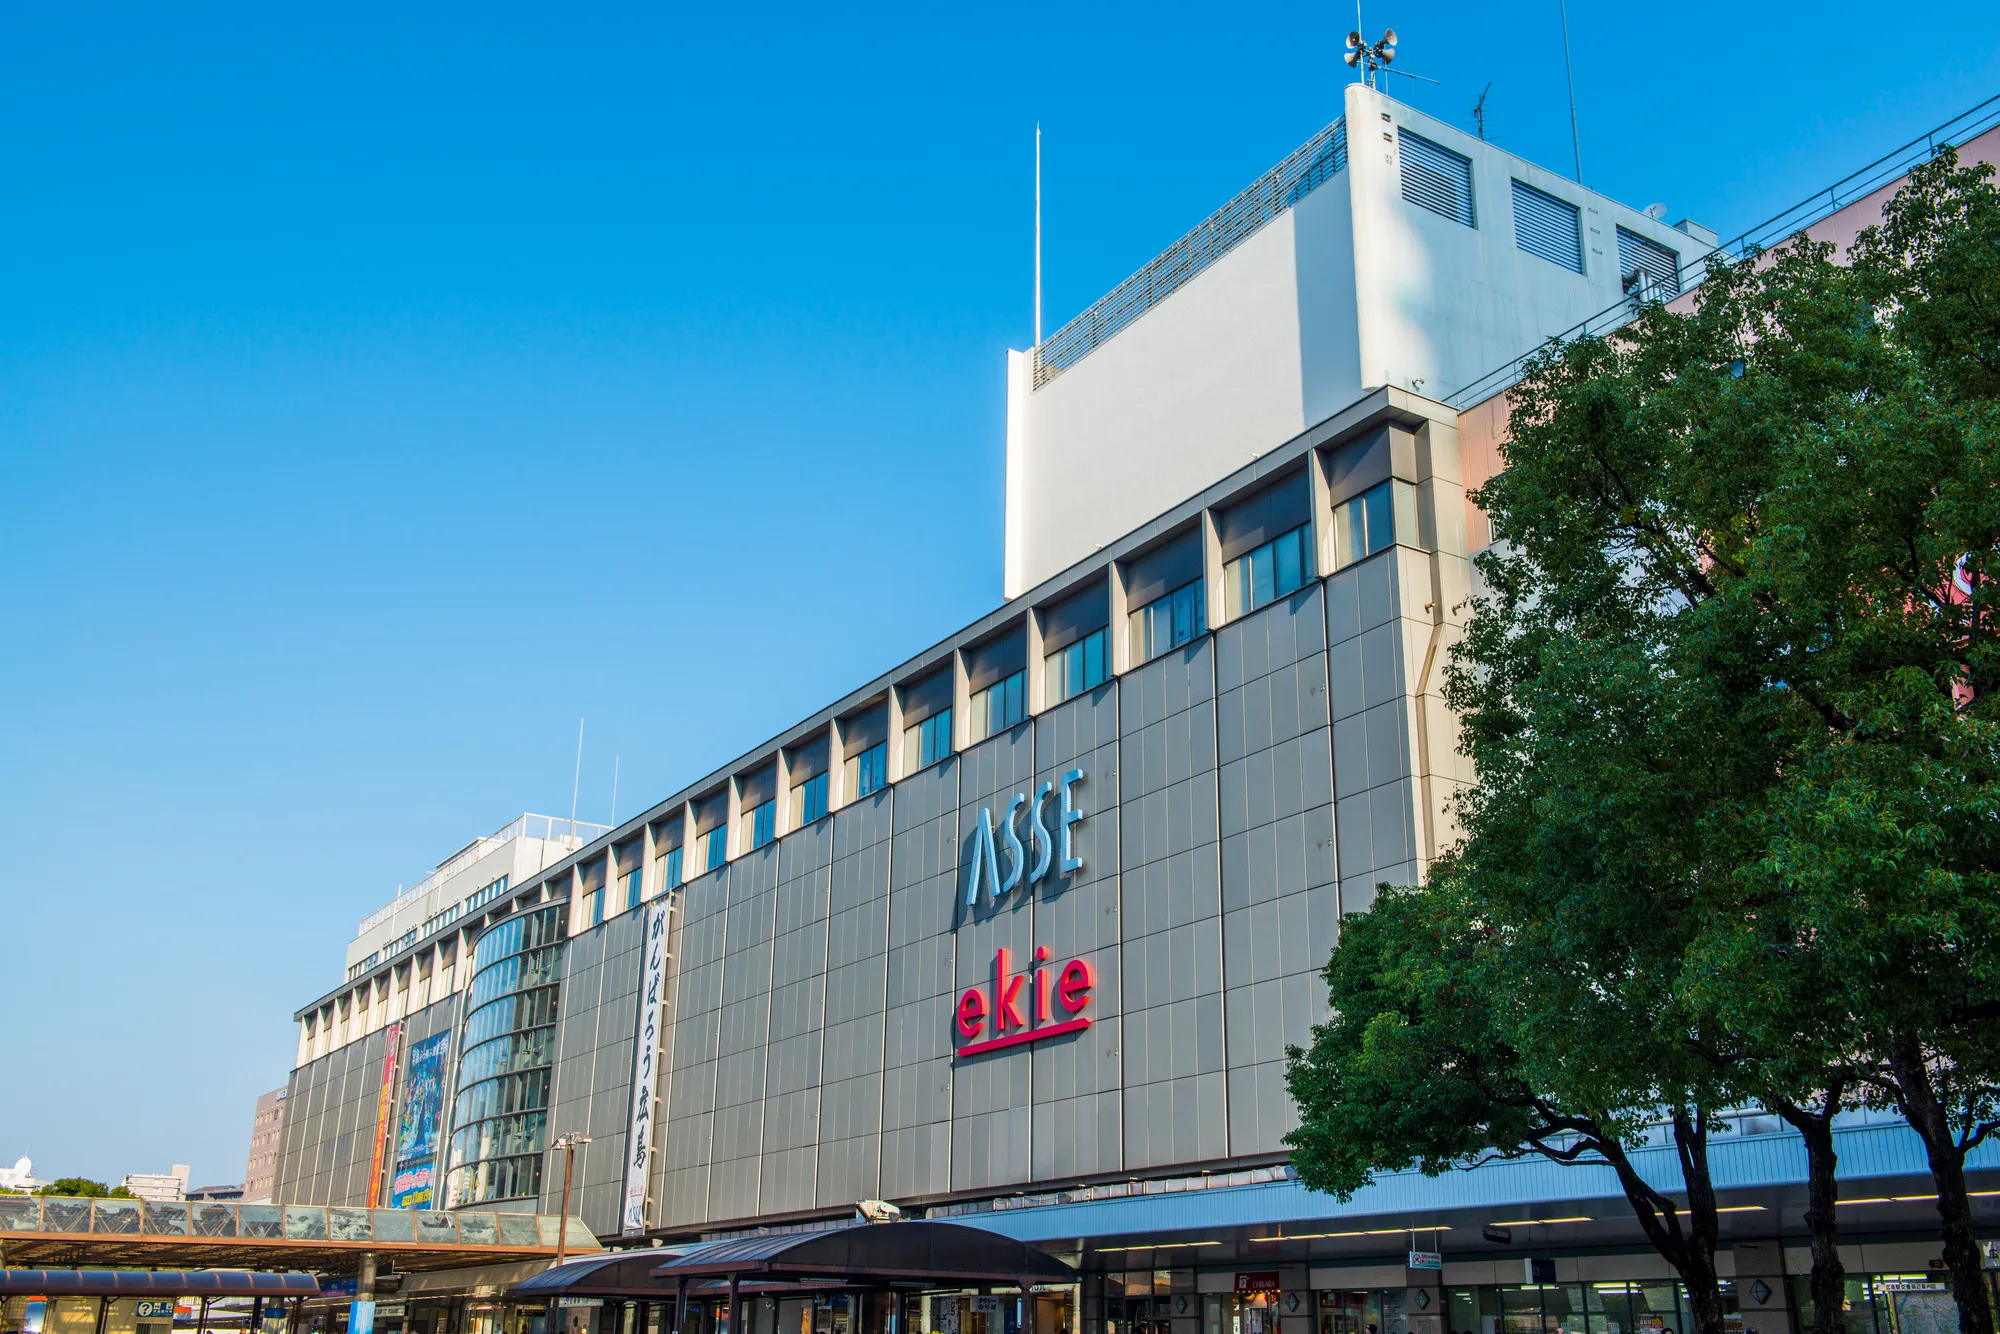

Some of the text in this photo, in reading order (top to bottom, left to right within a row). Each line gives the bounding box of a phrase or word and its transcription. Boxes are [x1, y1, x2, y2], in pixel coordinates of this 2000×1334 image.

[966, 768, 1083, 906] ASSE
[957, 946, 1093, 1038] ekie
[633, 911, 665, 1170] がんばろう広島
[627, 1204, 641, 1223] ASSE
[630, 1183, 643, 1195] ekie
